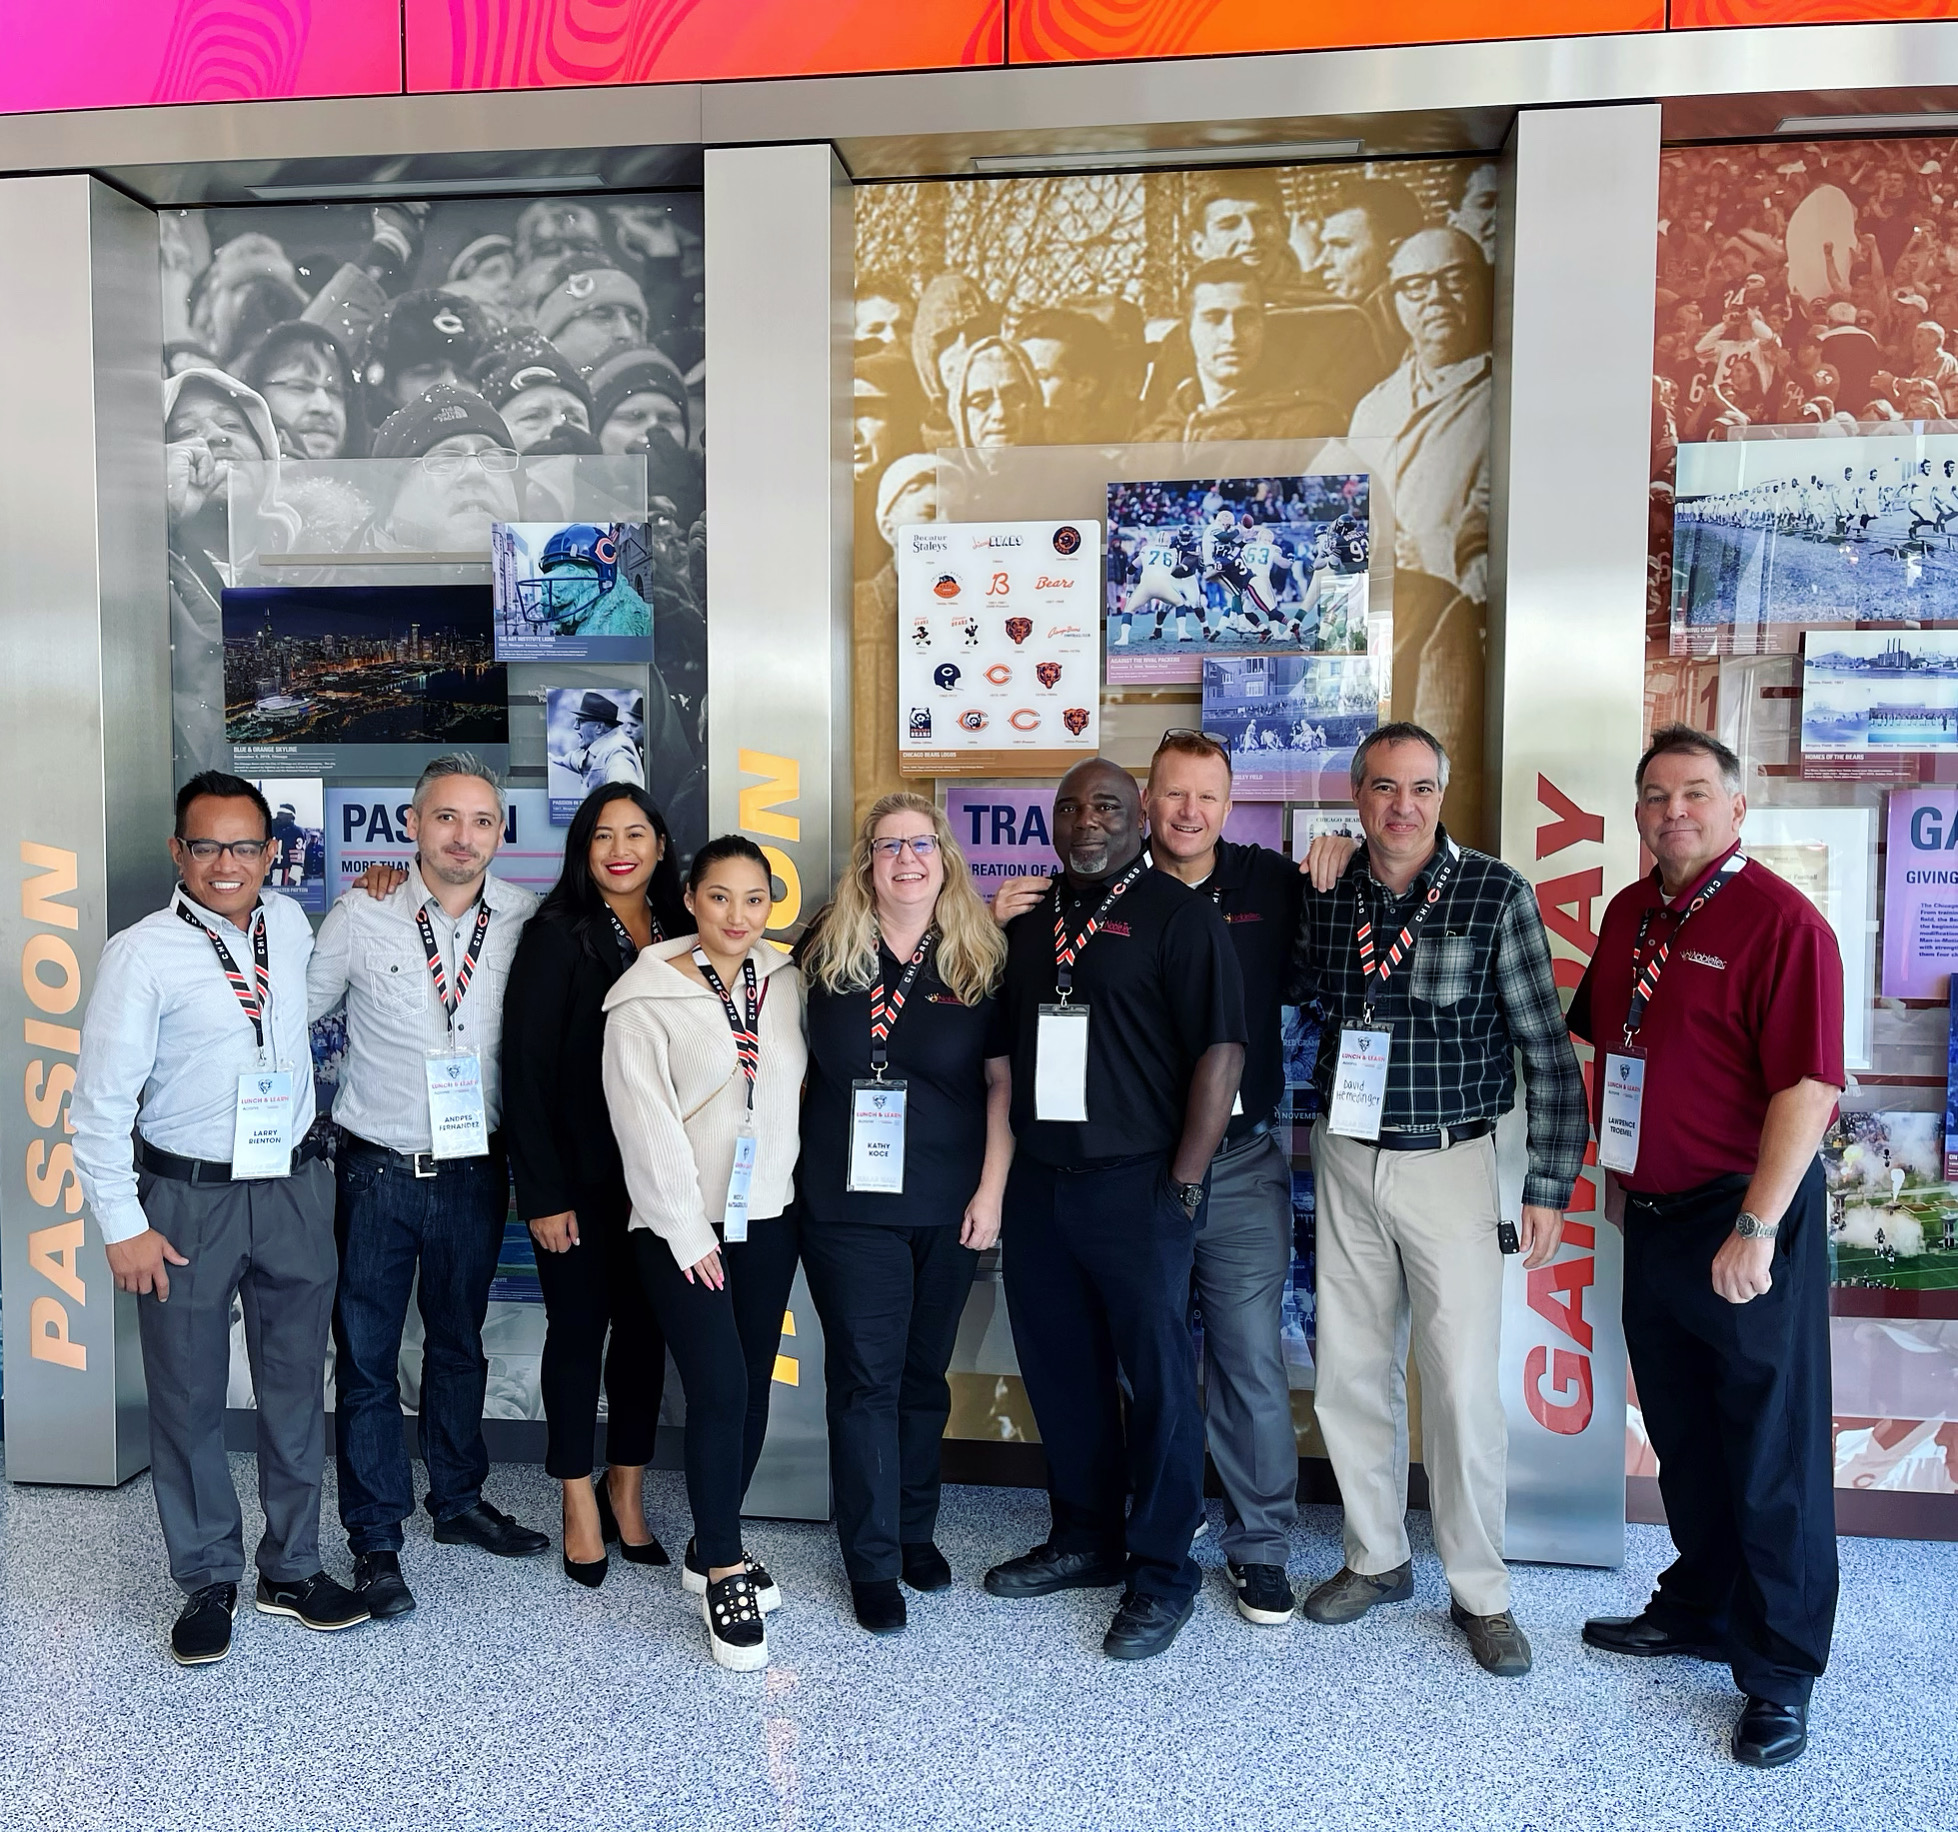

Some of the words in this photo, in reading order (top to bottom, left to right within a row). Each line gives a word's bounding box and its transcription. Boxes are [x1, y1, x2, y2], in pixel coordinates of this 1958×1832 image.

[913, 541, 947, 553] Staleys
[1148, 551, 1172, 567] 76
[1035, 576, 1074, 590] Bears
[971, 864, 1027, 877] REATION
[1031, 864, 1047, 876] OF
[1906, 870, 1958, 885] GIVING
[1415, 866, 1451, 922] CHICAGO
[904, 934, 932, 983] CHICAGO
[1343, 1080, 1365, 1091] David
[1607, 1081, 1623, 1089] LUNCH
[1627, 1084, 1641, 1092] LEARN
[20, 840, 87, 1371] PASSION
[270, 1095, 289, 1103] LEARN
[439, 1121, 480, 1131] FERNANDEZ
[1608, 1116, 1636, 1129] LAWRENCE
[253, 1129, 278, 1137] LARRY
[1610, 1125, 1633, 1138] TROEMEL
[1286, 1311, 1316, 1322] TEA
